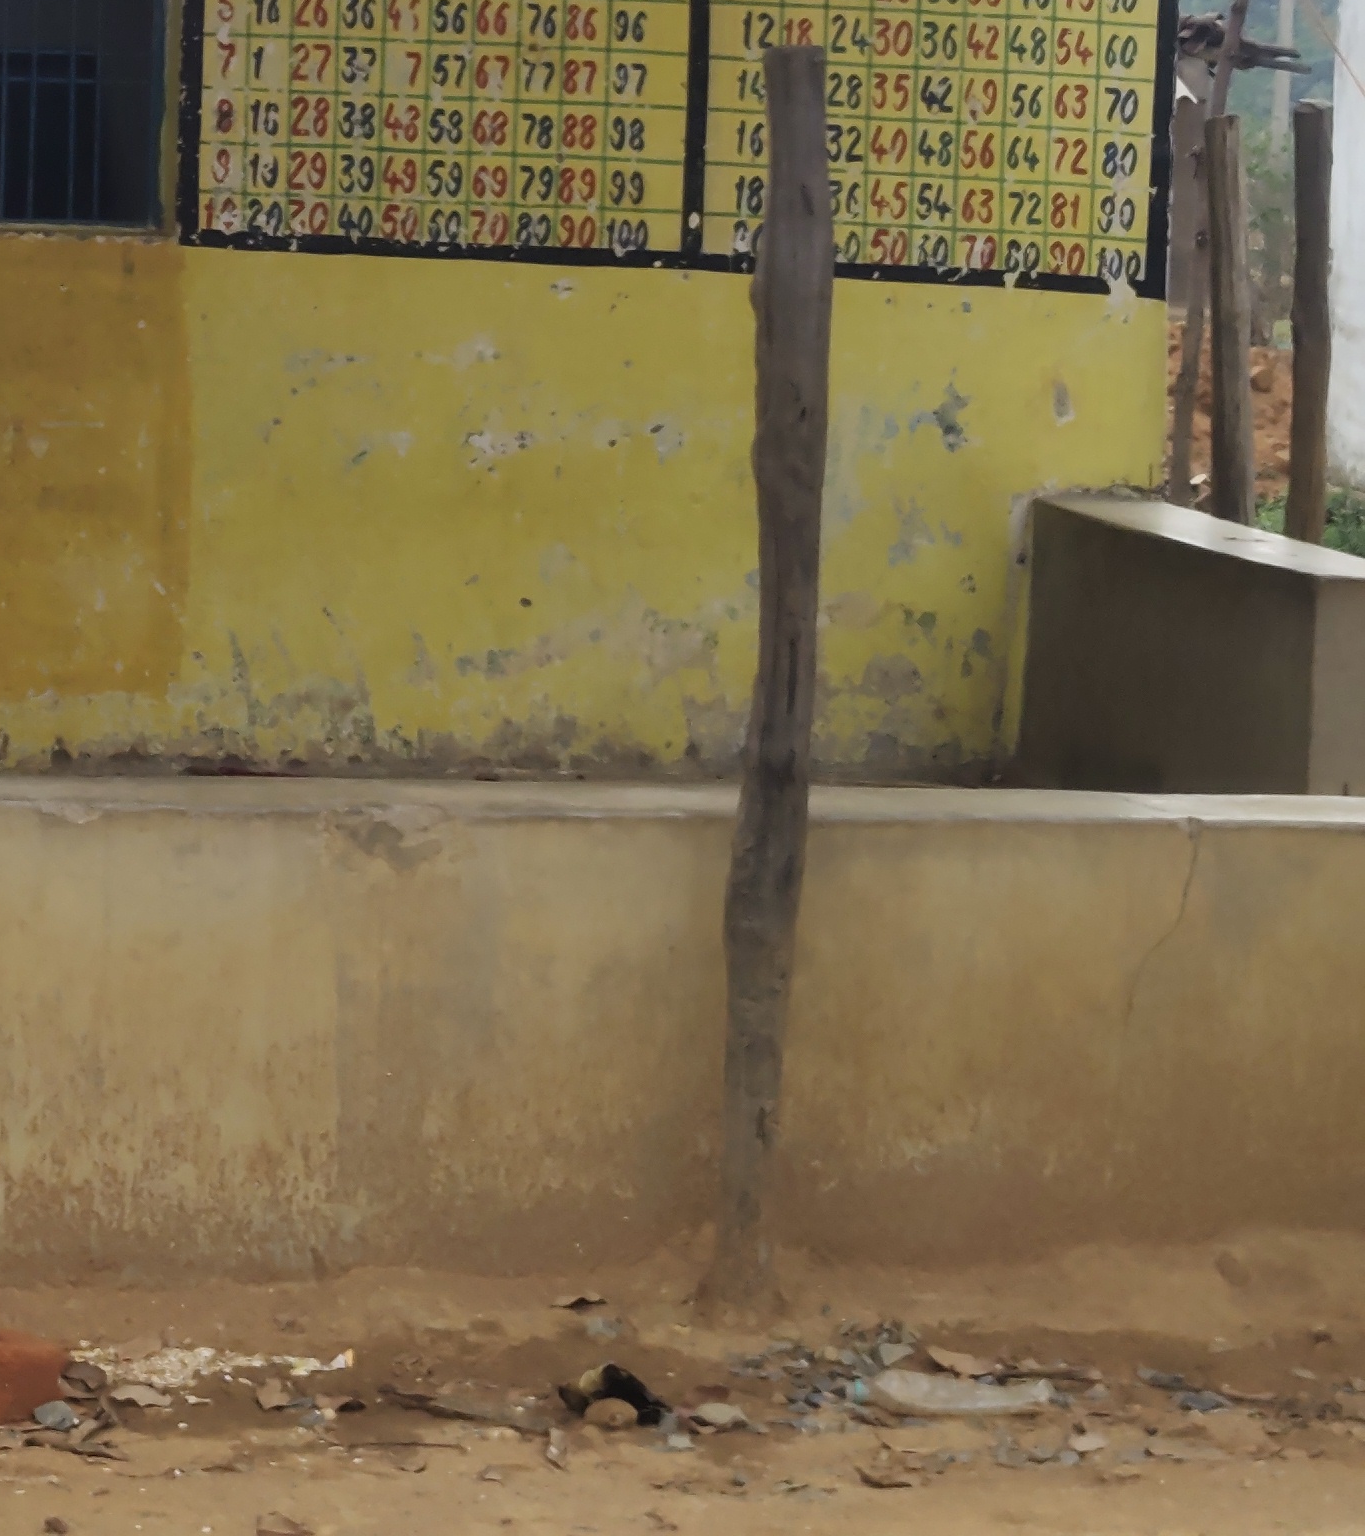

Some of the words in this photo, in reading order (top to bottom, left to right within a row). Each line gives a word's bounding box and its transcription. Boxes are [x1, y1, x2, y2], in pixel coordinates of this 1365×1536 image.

[527, 3, 558, 40] 76
[565, 3, 598, 42] 86
[614, 9, 648, 43] 96
